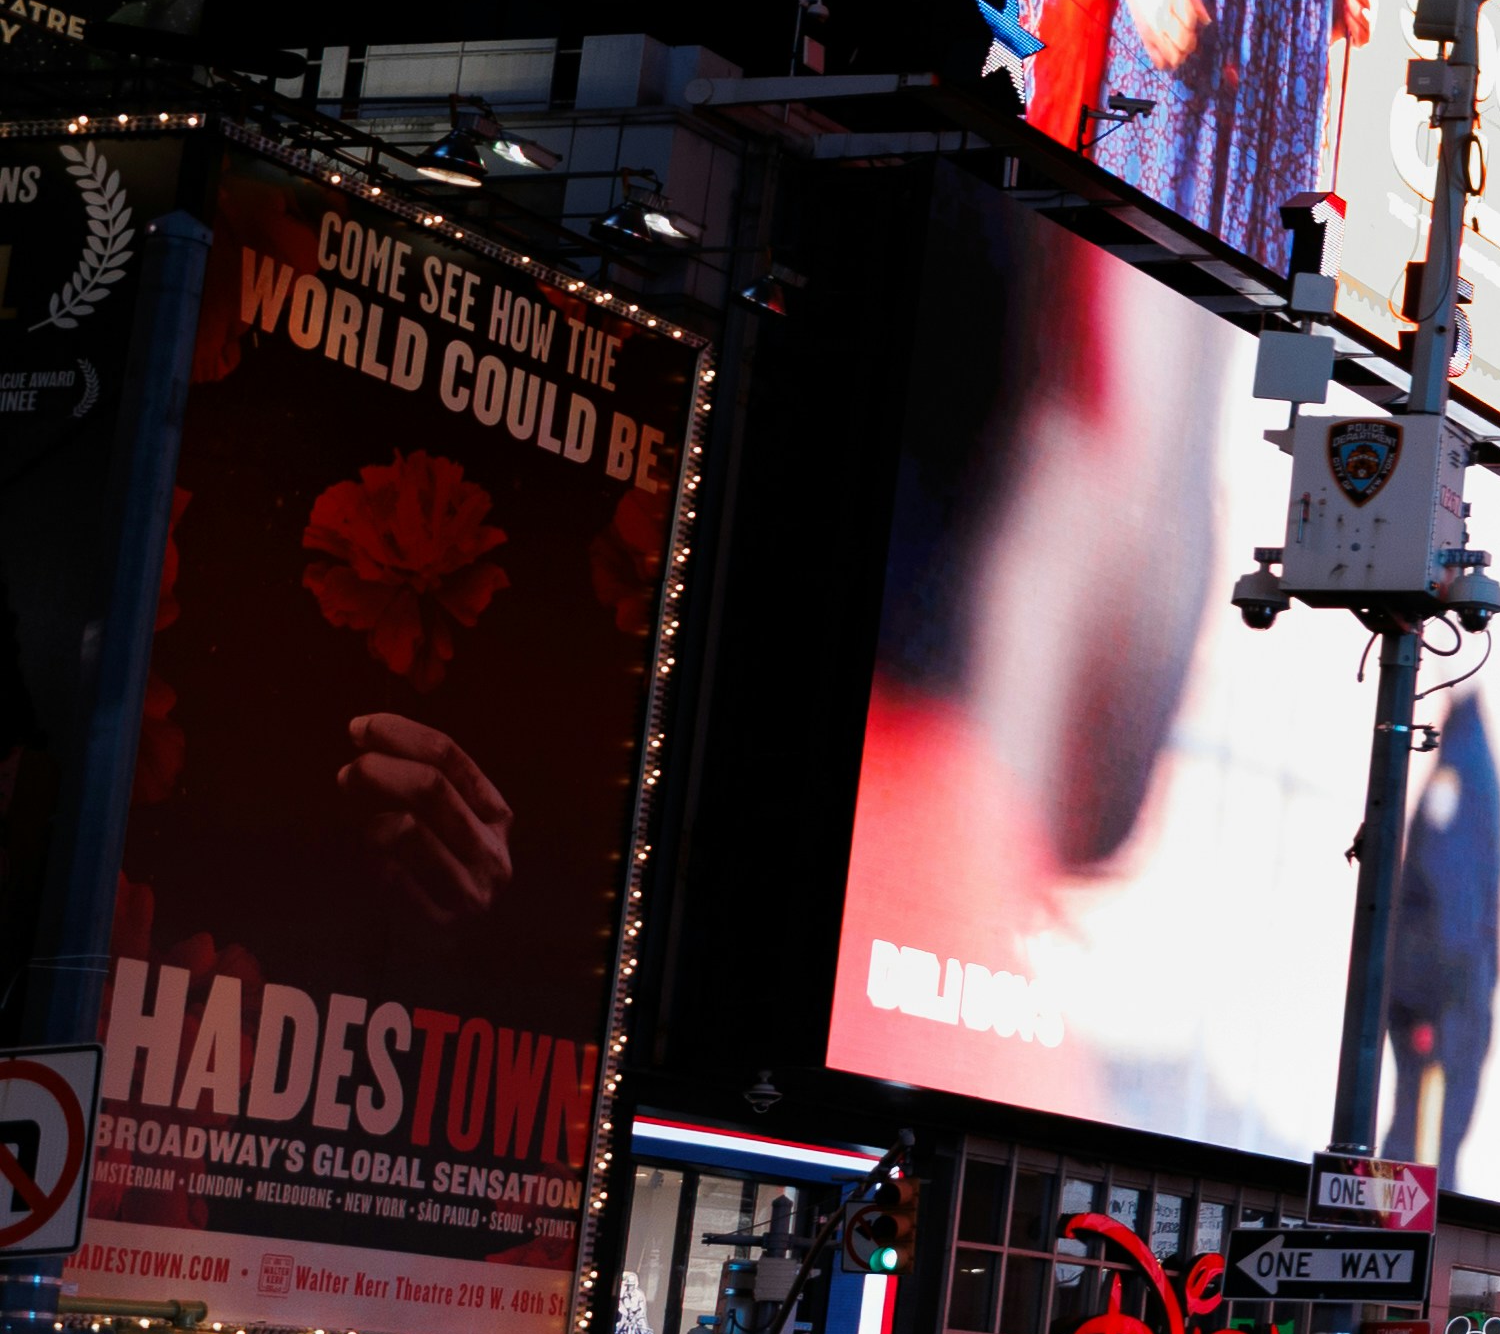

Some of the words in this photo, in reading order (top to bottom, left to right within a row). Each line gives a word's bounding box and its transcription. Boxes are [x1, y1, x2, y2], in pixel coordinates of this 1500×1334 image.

[317, 211, 414, 302] COME
[420, 256, 478, 331] SEE
[487, 288, 556, 363] HOW
[566, 317, 623, 392] THE
[29, 370, 76, 388] AWARD
[242, 247, 428, 391] WORLD
[439, 341, 597, 463] COULD
[605, 411, 664, 493] BE
[1333, 434, 1398, 447] DEPARTMENT
[1348, 424, 1386, 433] POLICE
[102, 958, 597, 1167] HADESTOWN
[96, 1115, 305, 1173] BROADWAY'S
[313, 1147, 425, 1189] GLOBAL
[433, 1162, 582, 1210] SENSATION
[188, 1172, 242, 1199] LONDON
[256, 1181, 333, 1208] MELBOURNE
[345, 1193, 373, 1213] NEW
[375, 1196, 406, 1218] YORK
[418, 1199, 440, 1223] SÃO
[443, 1206, 479, 1228] PAULO
[489, 1211, 524, 1234] SEOUL
[534, 1217, 578, 1240] SYDNEY
[1330, 1177, 1365, 1206] ONE
[1383, 1181, 1418, 1211] WAY
[1257, 1250, 1312, 1278] ONE
[1340, 1253, 1402, 1279] WAY
[296, 1266, 349, 1292] Walter
[354, 1272, 389, 1298] Kerr
[395, 1276, 454, 1305] Theatre
[457, 1284, 484, 1307] 219
[489, 1288, 505, 1311] W.
[511, 1290, 544, 1315] 48th
[548, 1293, 568, 1317] St.
